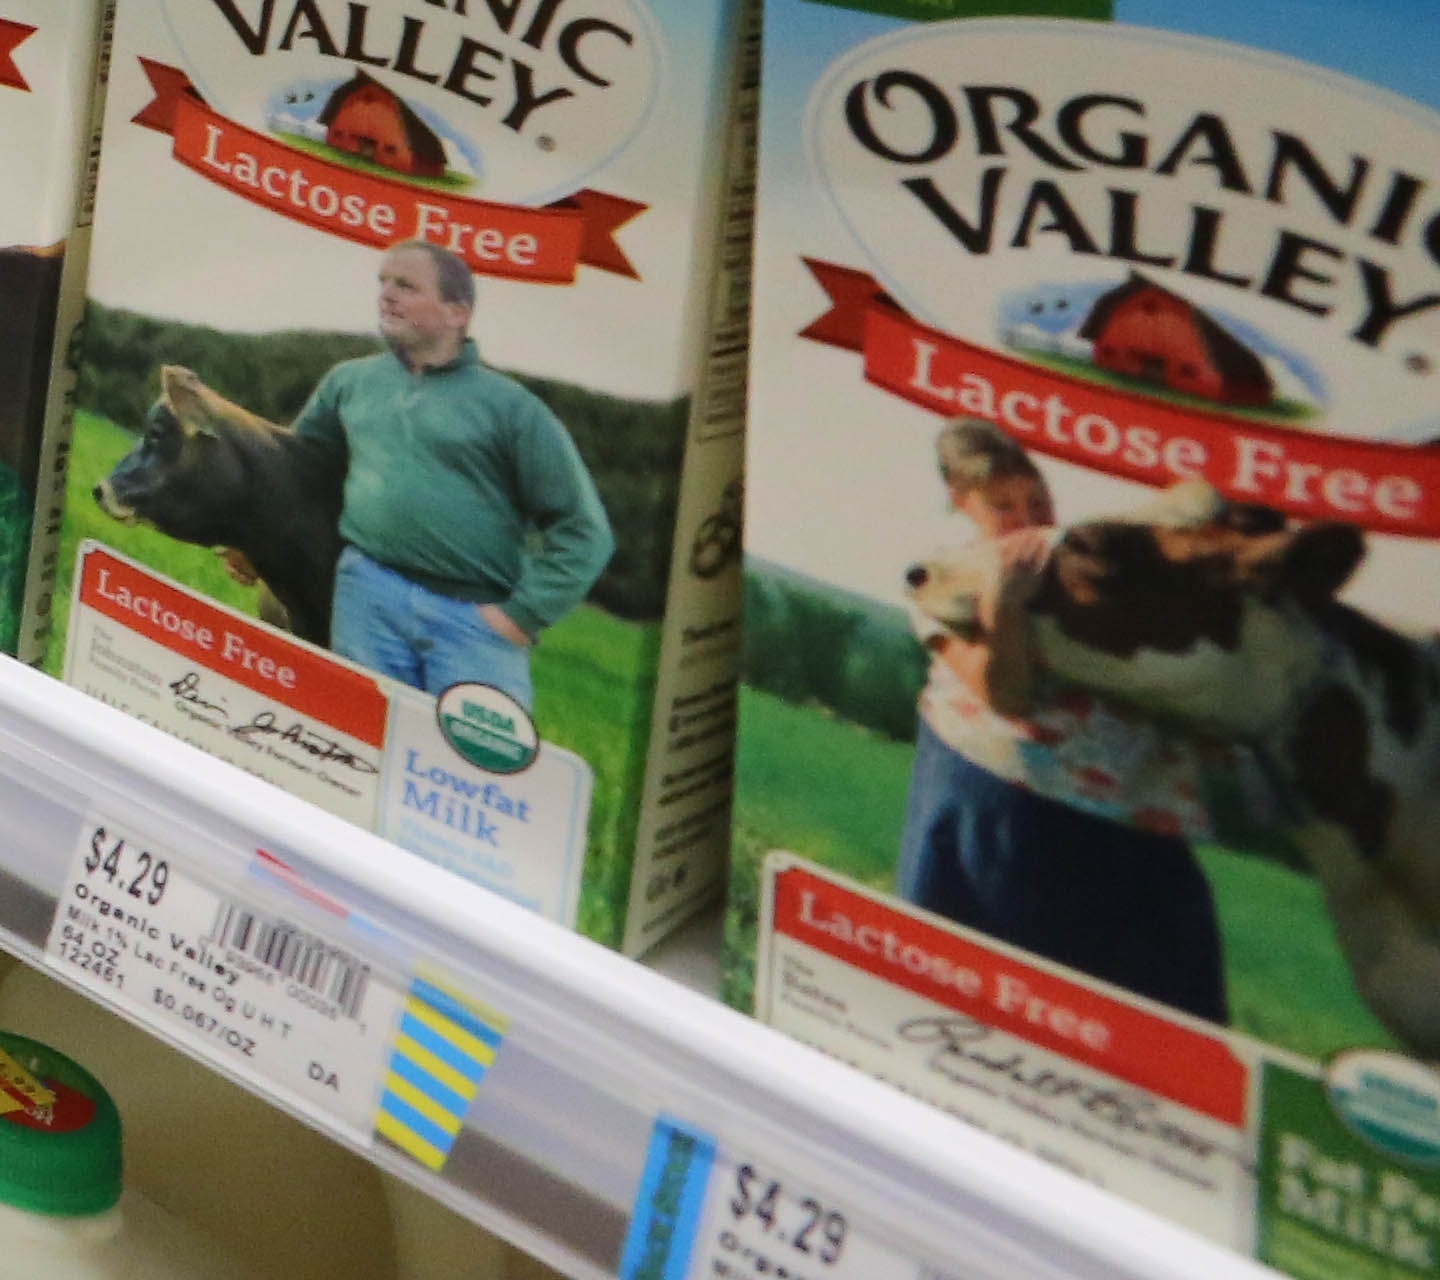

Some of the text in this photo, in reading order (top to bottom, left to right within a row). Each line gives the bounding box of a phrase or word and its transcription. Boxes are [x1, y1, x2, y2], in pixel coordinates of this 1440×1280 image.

[203, 124, 541, 272] Lactose Free
[96, 567, 217, 652] Lactose
[223, 631, 298, 691] Free
[84, 827, 169, 907] $4.29
[731, 1161, 849, 1267] $4.29
